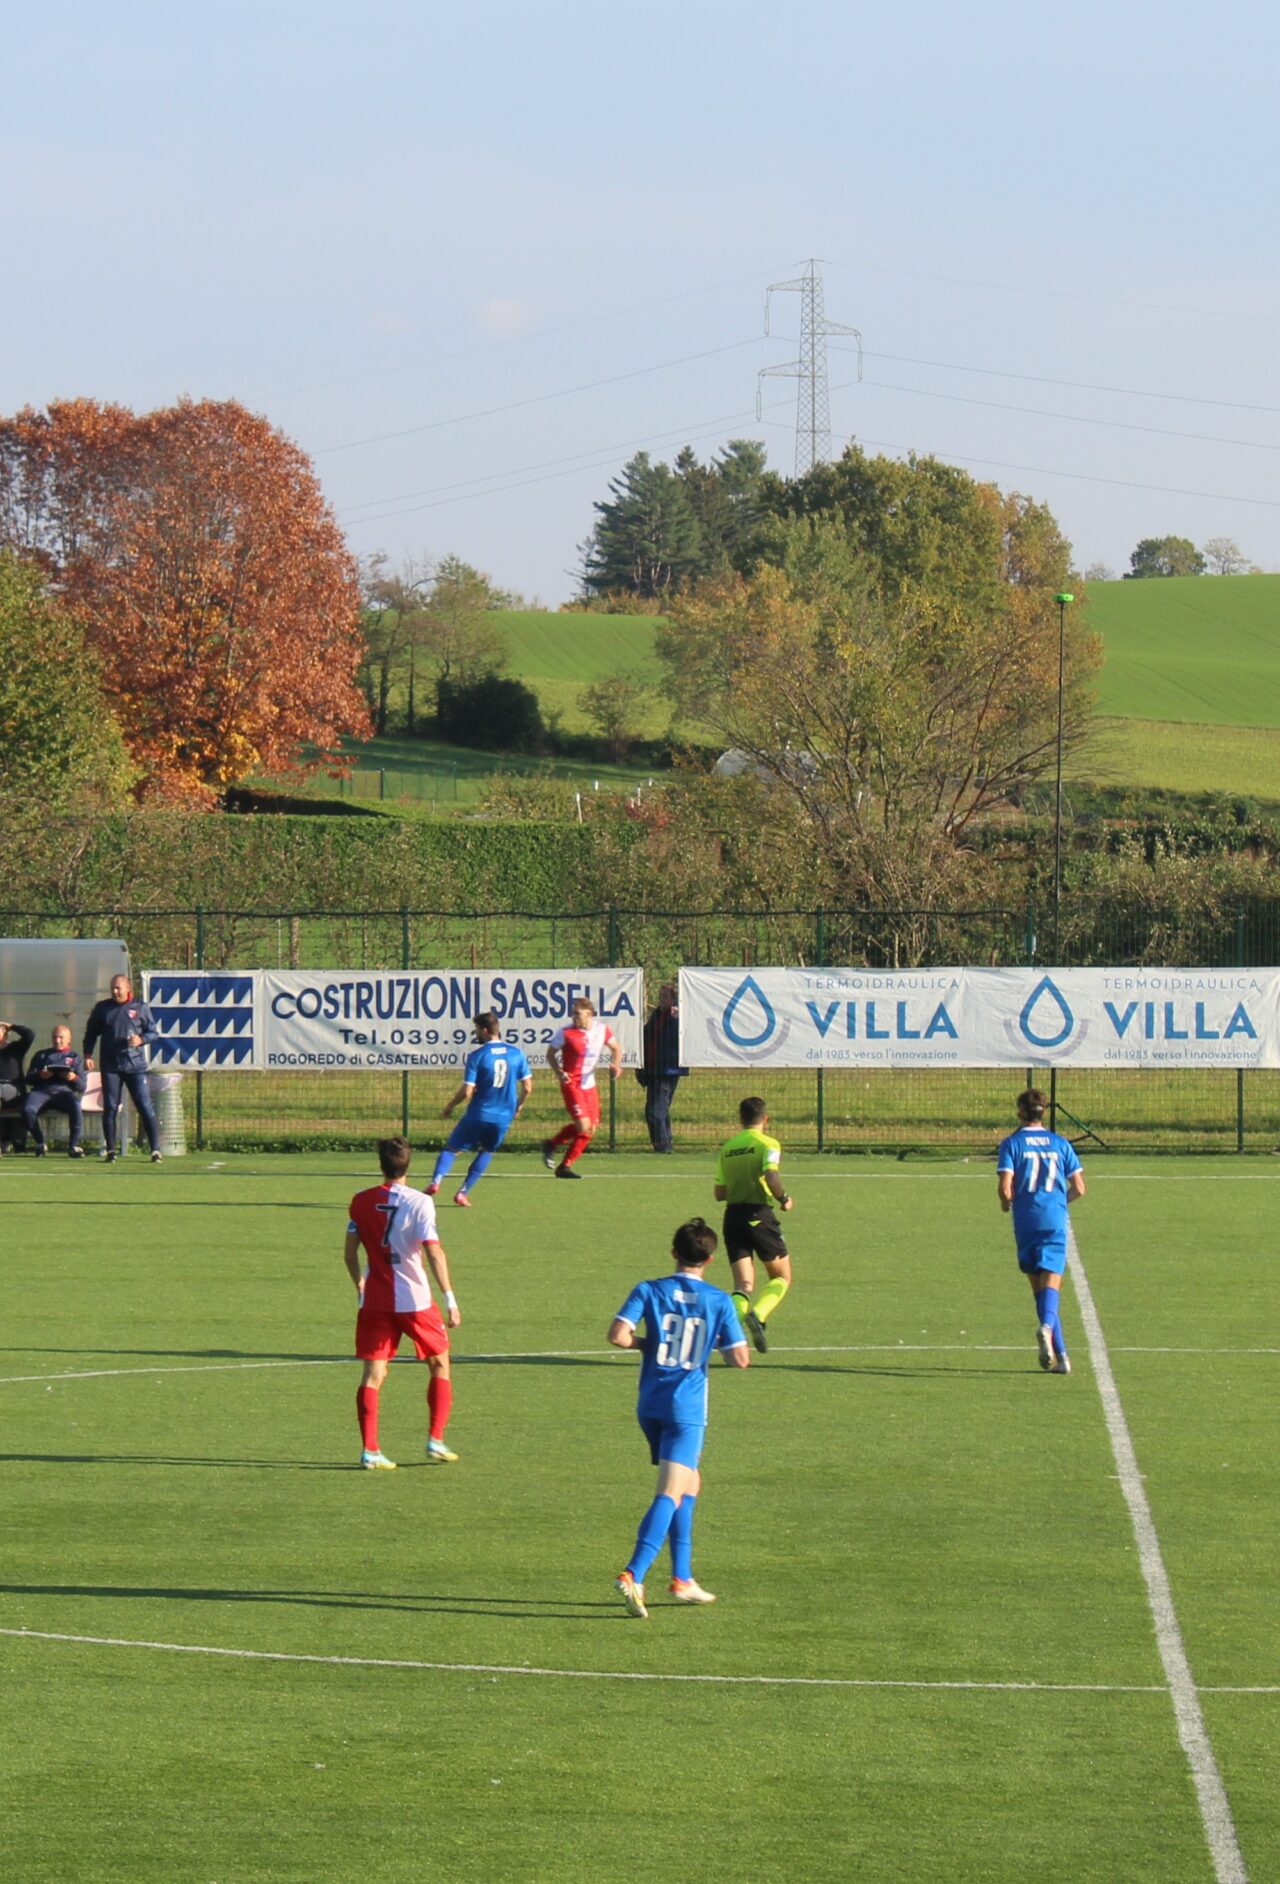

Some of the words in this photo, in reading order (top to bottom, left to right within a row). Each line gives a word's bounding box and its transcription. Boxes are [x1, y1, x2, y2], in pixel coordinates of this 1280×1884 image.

[271, 976, 480, 1019] COSTRUZIONI
[805, 977, 960, 989] TERMOIDRAULICA
[1103, 977, 1259, 989] TERMOIDRAULICA
[805, 1001, 959, 1039] VILLA
[1103, 1001, 1258, 1039] VILLA
[268, 1053, 346, 1065] ROGOREDO
[350, 1052, 362, 1065] di
[366, 1053, 458, 1065] CASATENOVO
[806, 1048, 822, 1060] dal
[826, 1049, 850, 1060] 1983
[853, 1050, 883, 1060] verso
[885, 1048, 958, 1060] l'innovazione
[1104, 1048, 1120, 1060] dal
[1125, 1049, 1148, 1060] 1983
[1151, 1050, 1182, 1060] verso
[1022, 1151, 1059, 1193] 77
[375, 1203, 400, 1247] 7
[656, 1312, 708, 1370] 30
